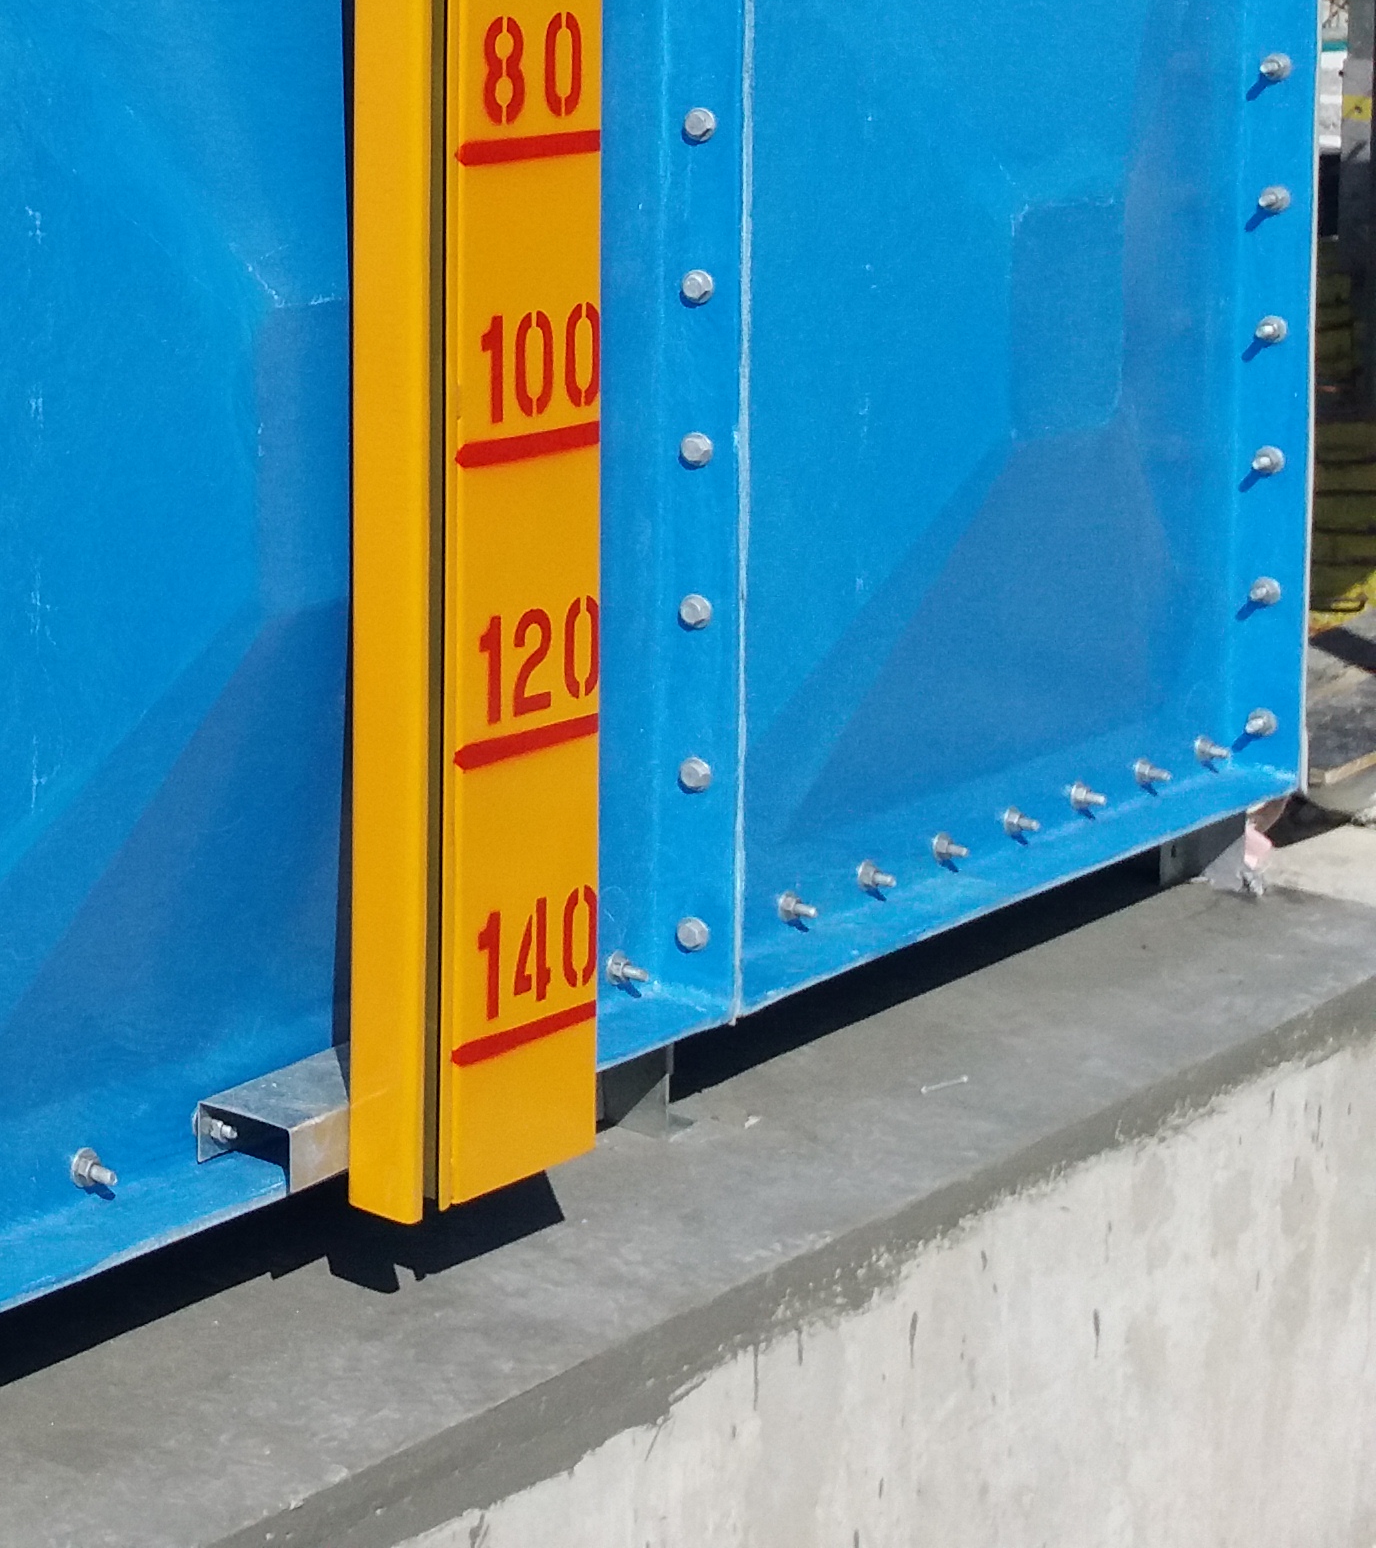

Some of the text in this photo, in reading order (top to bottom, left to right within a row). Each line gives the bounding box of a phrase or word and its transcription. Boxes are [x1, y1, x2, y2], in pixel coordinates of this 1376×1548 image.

[484, 12, 582, 126] 80
[480, 301, 600, 424] 100
[479, 595, 599, 725] 120
[477, 884, 597, 1021] 140
